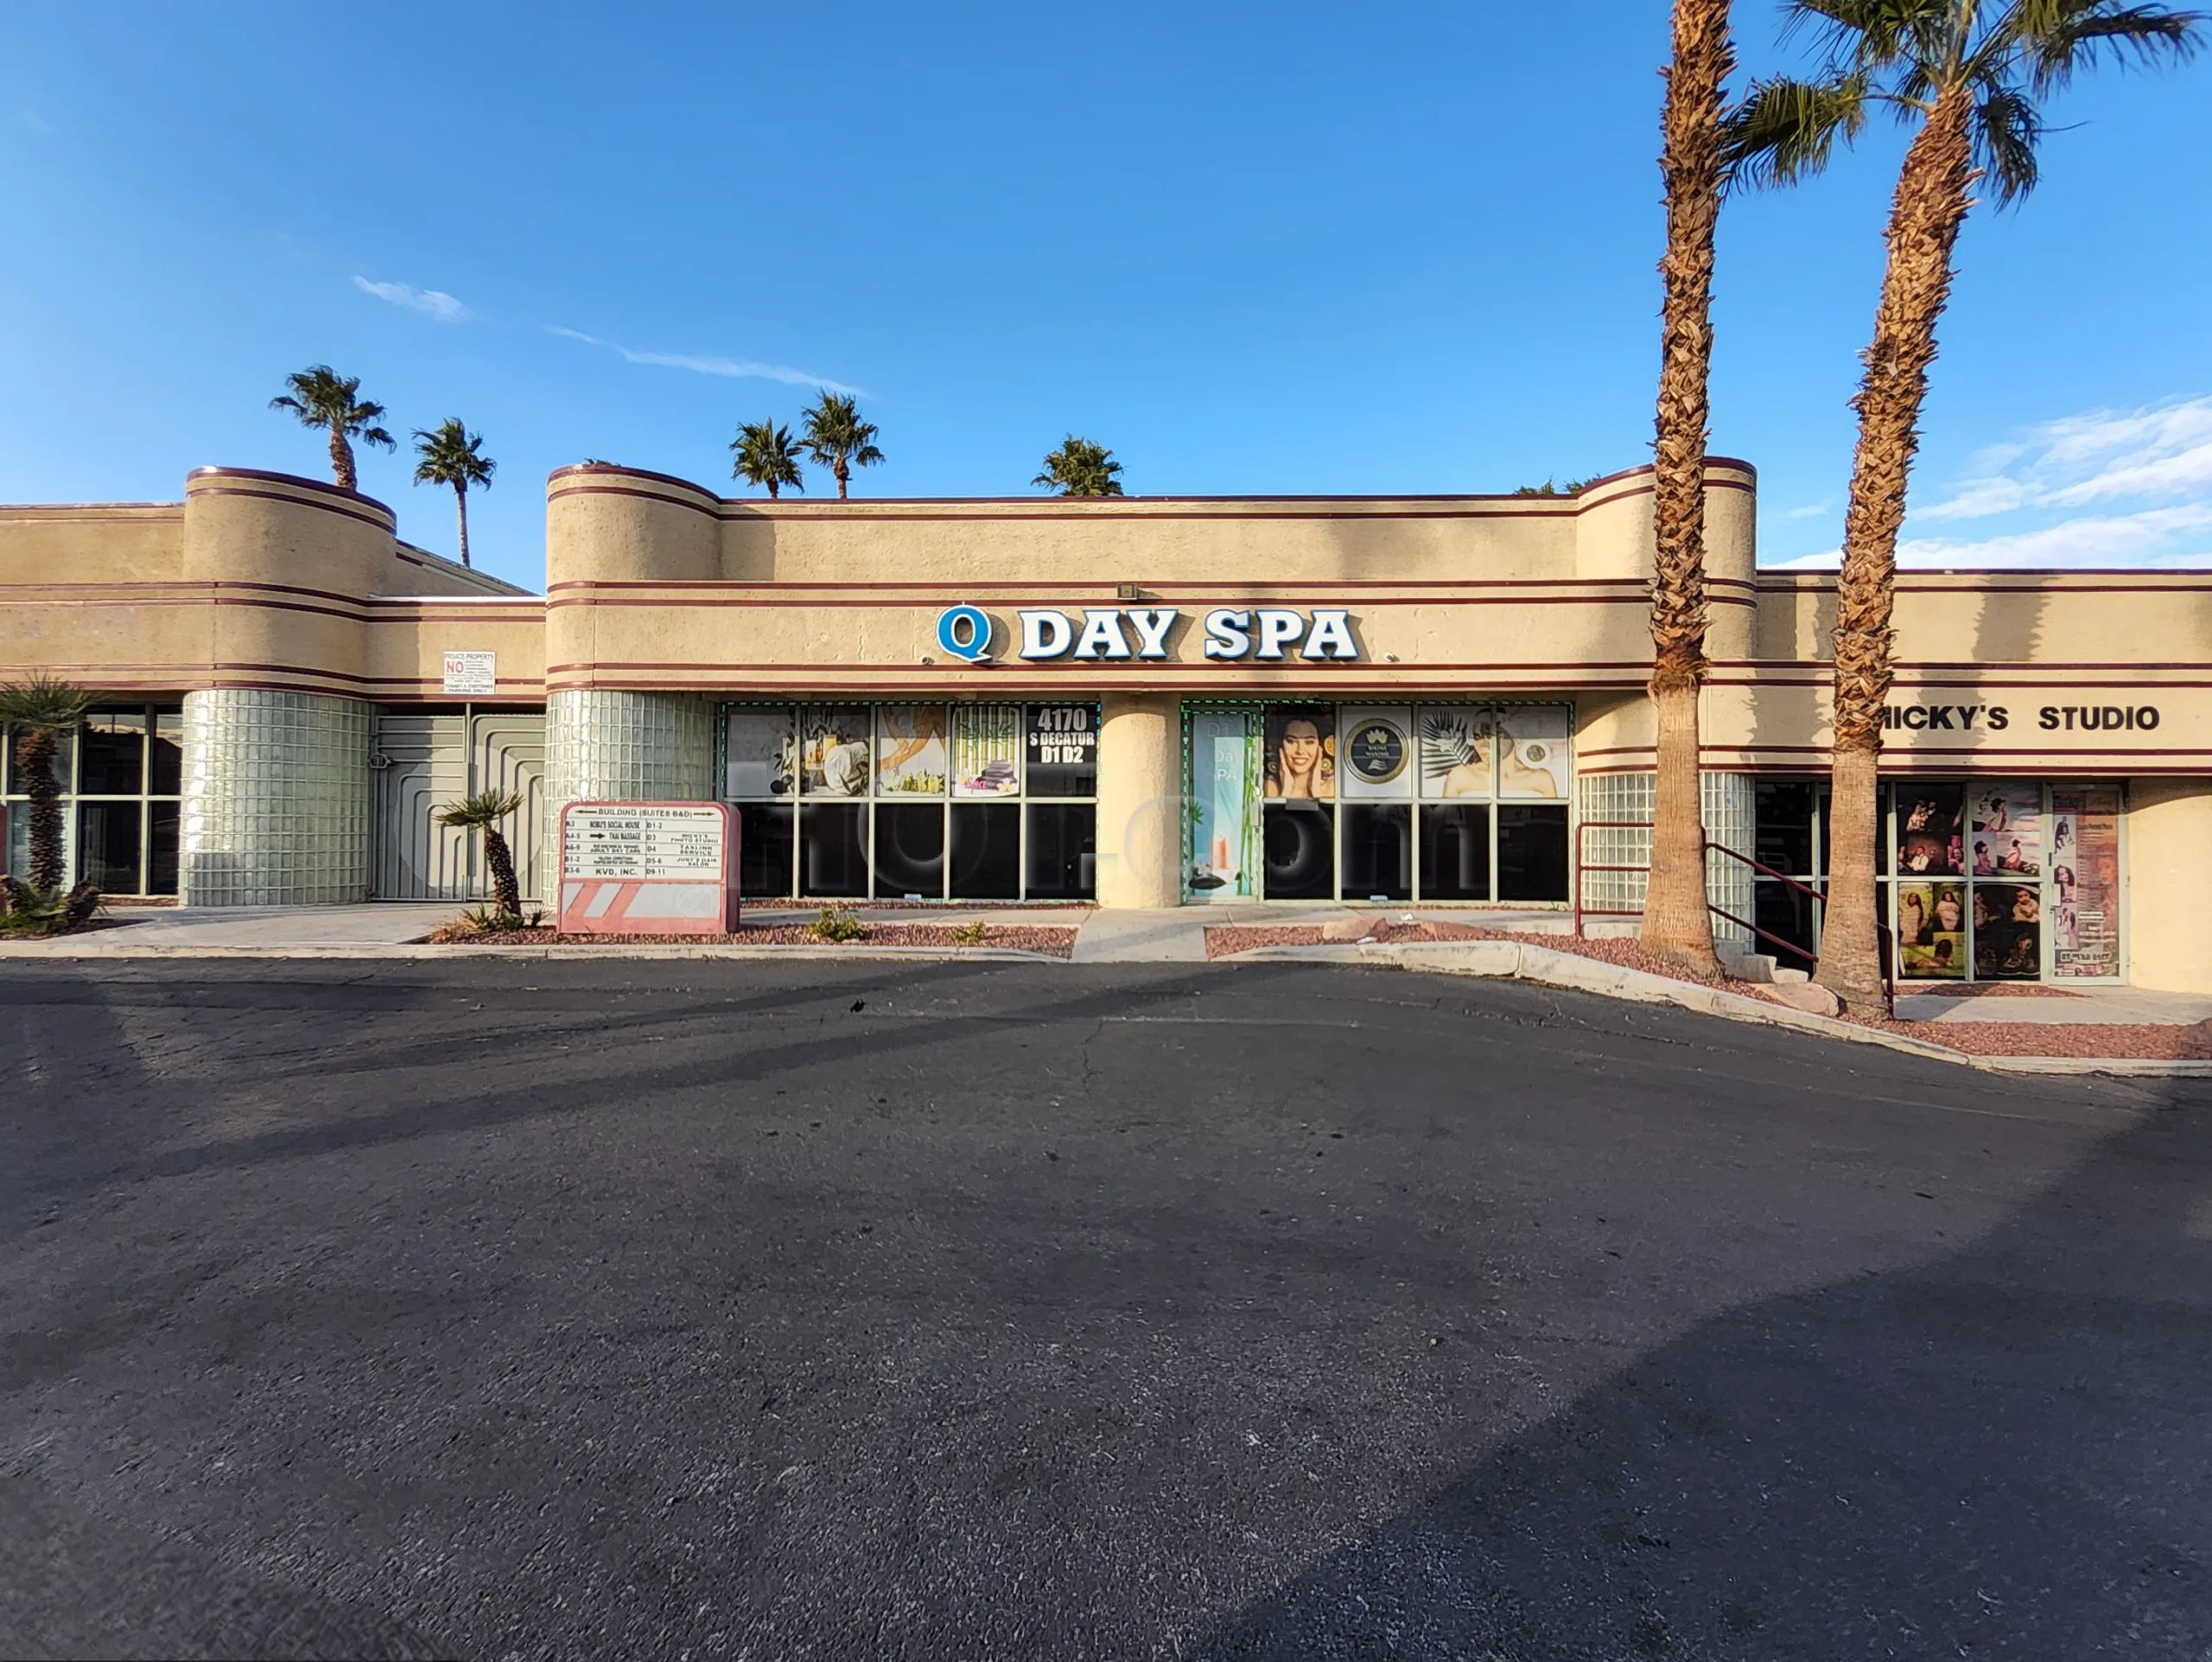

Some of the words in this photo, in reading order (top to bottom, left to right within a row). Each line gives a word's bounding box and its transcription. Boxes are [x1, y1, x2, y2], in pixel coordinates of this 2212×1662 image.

[936, 604, 994, 663] Q
[1017, 608, 1179, 659] DAY
[1205, 608, 1359, 659] SPA
[446, 660, 464, 673] NO
[1038, 707, 1087, 731] 4170
[2037, 705, 2160, 730] STUDIO
[1029, 731, 1039, 747] S
[1039, 731, 1095, 746] DECATUR
[1040, 746, 1060, 763] D1
[1062, 746, 1084, 763] D2
[598, 808, 637, 817] BUILDING
[595, 868, 617, 876] KVD,
